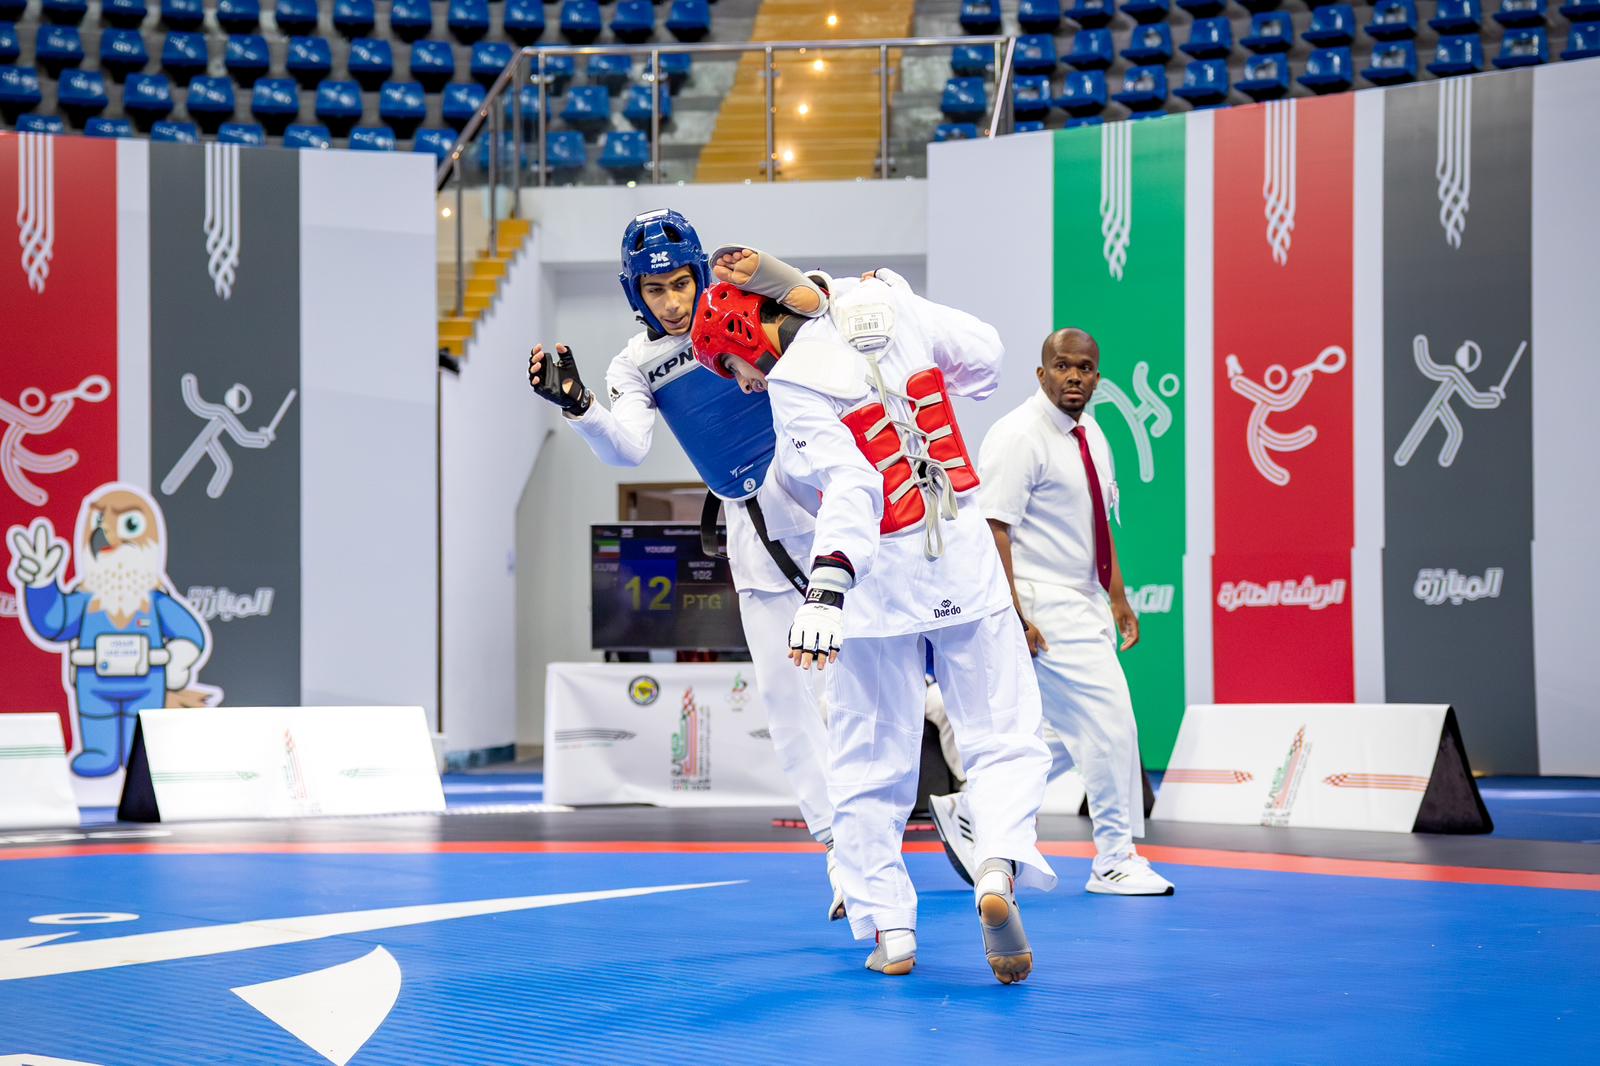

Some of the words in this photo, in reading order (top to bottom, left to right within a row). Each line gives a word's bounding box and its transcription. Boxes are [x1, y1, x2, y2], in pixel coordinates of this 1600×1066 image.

[648, 346, 694, 383] KPN
[624, 575, 672, 610] 12
[683, 594, 723, 610] PTG
[1414, 567, 1504, 605] المبارزة
[933, 605, 962, 619] Daedo
